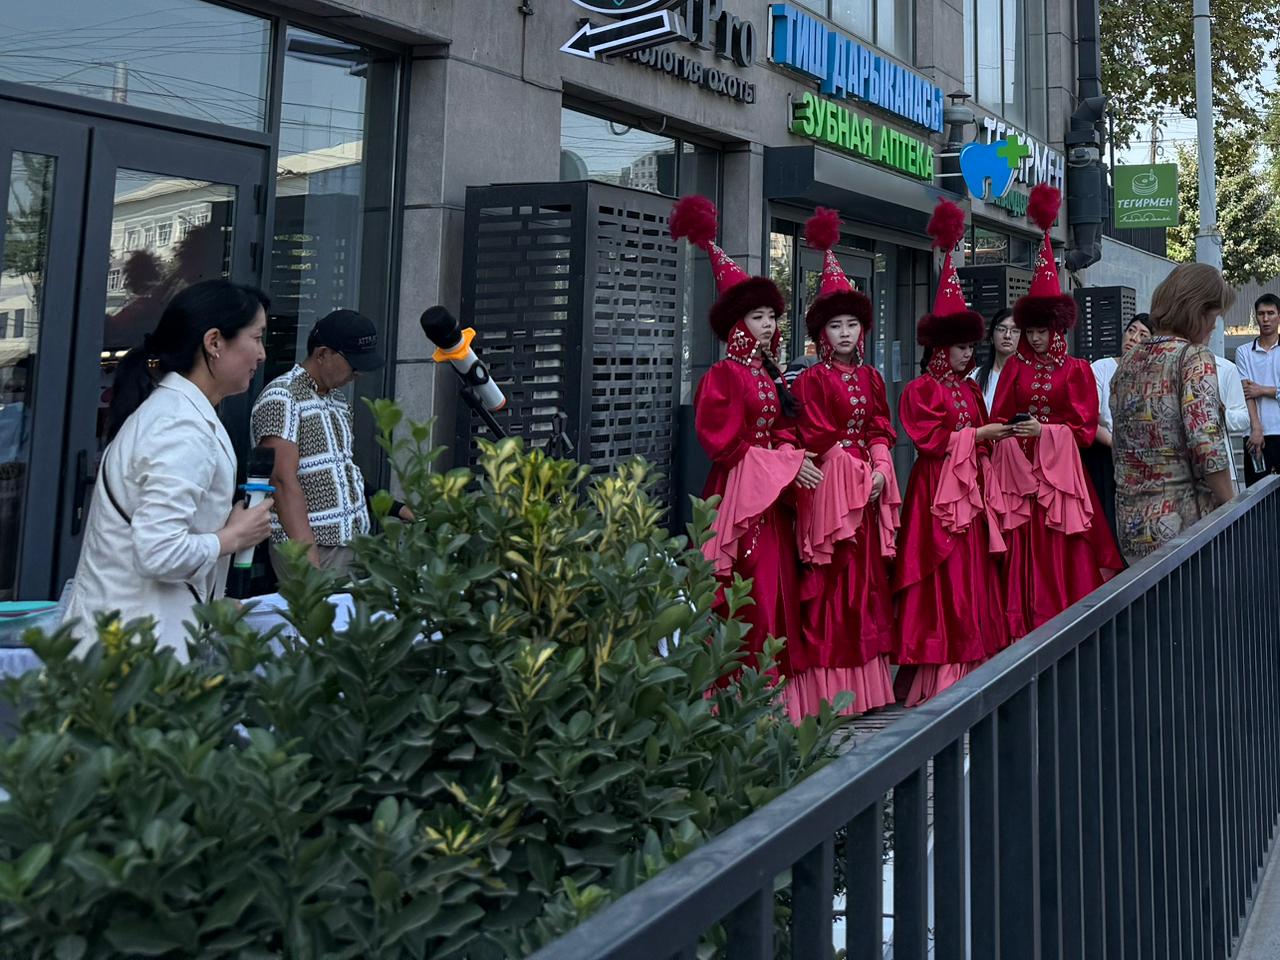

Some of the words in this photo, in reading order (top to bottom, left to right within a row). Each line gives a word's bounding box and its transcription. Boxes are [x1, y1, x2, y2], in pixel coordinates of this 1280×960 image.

[774, 3, 828, 82] ТИШ
[829, 32, 945, 134] ДАРЫКАНАСЫ
[798, 91, 873, 157] ЗУБНАЯ
[878, 125, 935, 182] АПТЕКА
[1117, 197, 1174, 209] ТЕГИРМЕН
